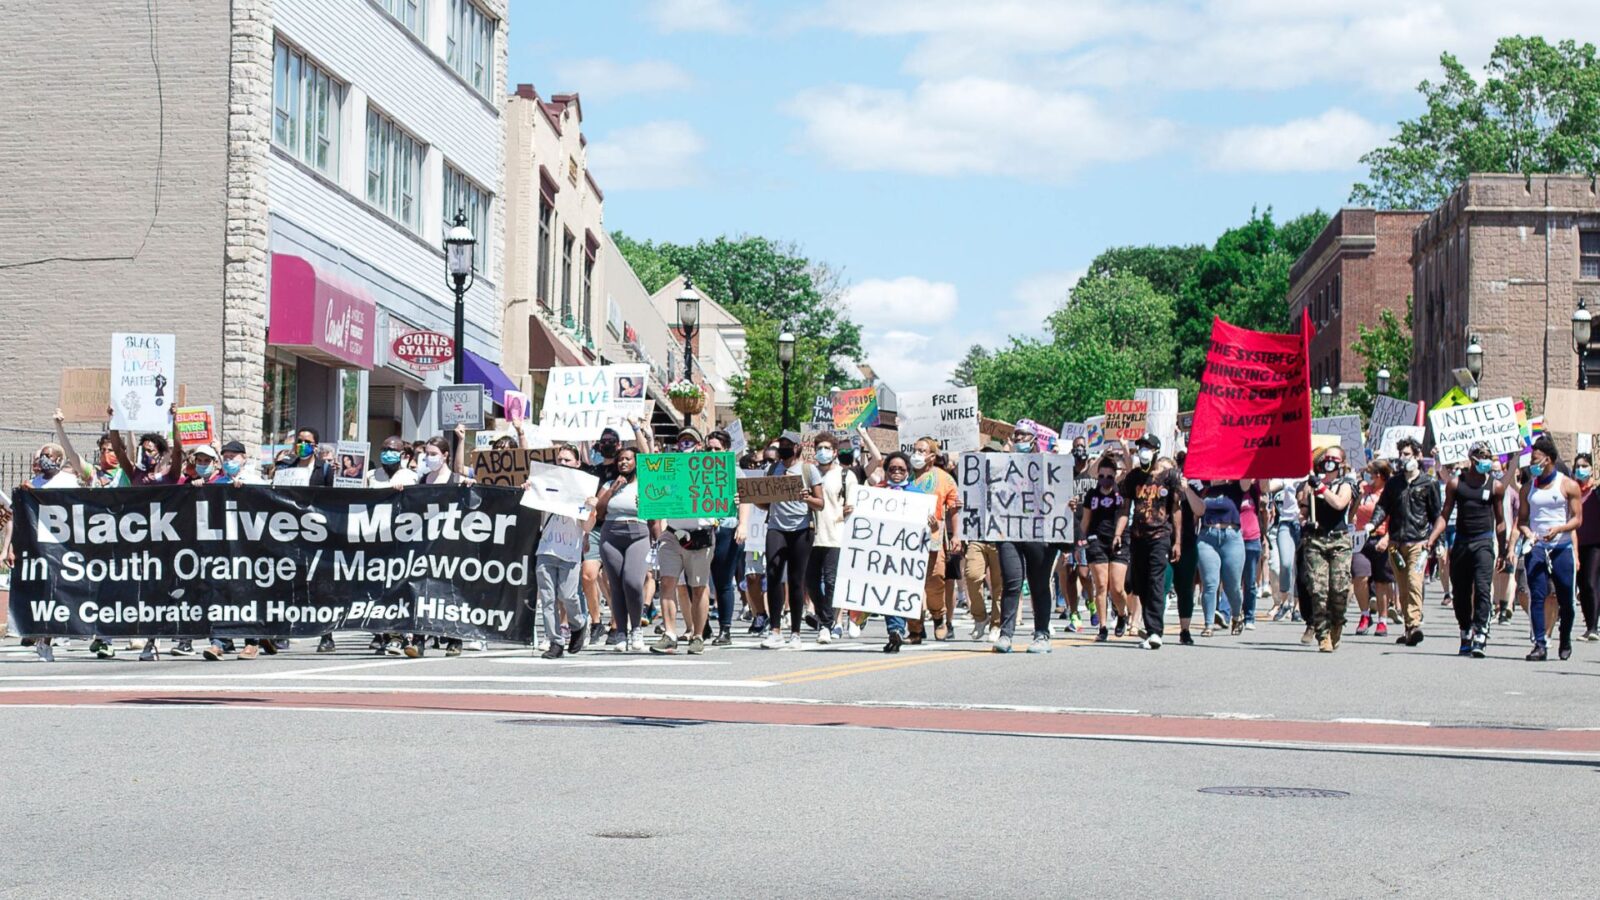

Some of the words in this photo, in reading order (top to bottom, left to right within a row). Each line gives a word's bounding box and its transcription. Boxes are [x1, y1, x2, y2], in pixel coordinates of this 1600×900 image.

[125, 336, 160, 349] BLACK
[402, 333, 449, 346] COINS
[398, 344, 452, 357] STAMPS
[1236, 348, 1283, 365] SYSTEM
[123, 361, 163, 373] LIVES
[1205, 361, 1270, 382] THINKING
[564, 369, 608, 386] BLA
[568, 390, 609, 405] LIVE
[932, 394, 958, 406] FREE
[940, 406, 975, 421] UNFREE
[1105, 400, 1147, 413] RACISM
[1376, 395, 1410, 417] BLACK
[1122, 413, 1147, 421] PUBLIC
[1221, 413, 1276, 427] SLAVERY
[1434, 402, 1510, 428] UNITED
[1243, 434, 1281, 449] LEGAL
[645, 457, 676, 472] WE
[688, 455, 726, 471] CON
[963, 455, 1061, 486] BLACK
[688, 470, 729, 485] VER
[688, 484, 727, 499] SAT
[691, 498, 729, 513] ION
[963, 491, 1055, 515] LIVES
[37, 500, 181, 545] Black
[195, 500, 328, 542] Lives
[347, 502, 517, 545] Matter
[963, 515, 1068, 540] MATTER
[851, 517, 930, 551] BLACK
[21, 551, 48, 582] in
[60, 550, 162, 582] South
[174, 549, 297, 588] Orange
[305, 549, 324, 582] /
[333, 549, 529, 589] Maplewood
[848, 547, 926, 581] TRANS
[845, 580, 920, 612] LIVES
[30, 600, 71, 623] We
[78, 600, 202, 623] Celebrate
[207, 600, 257, 623] and
[266, 600, 344, 623] Honor
[349, 598, 410, 620] Black
[416, 596, 514, 632] History
